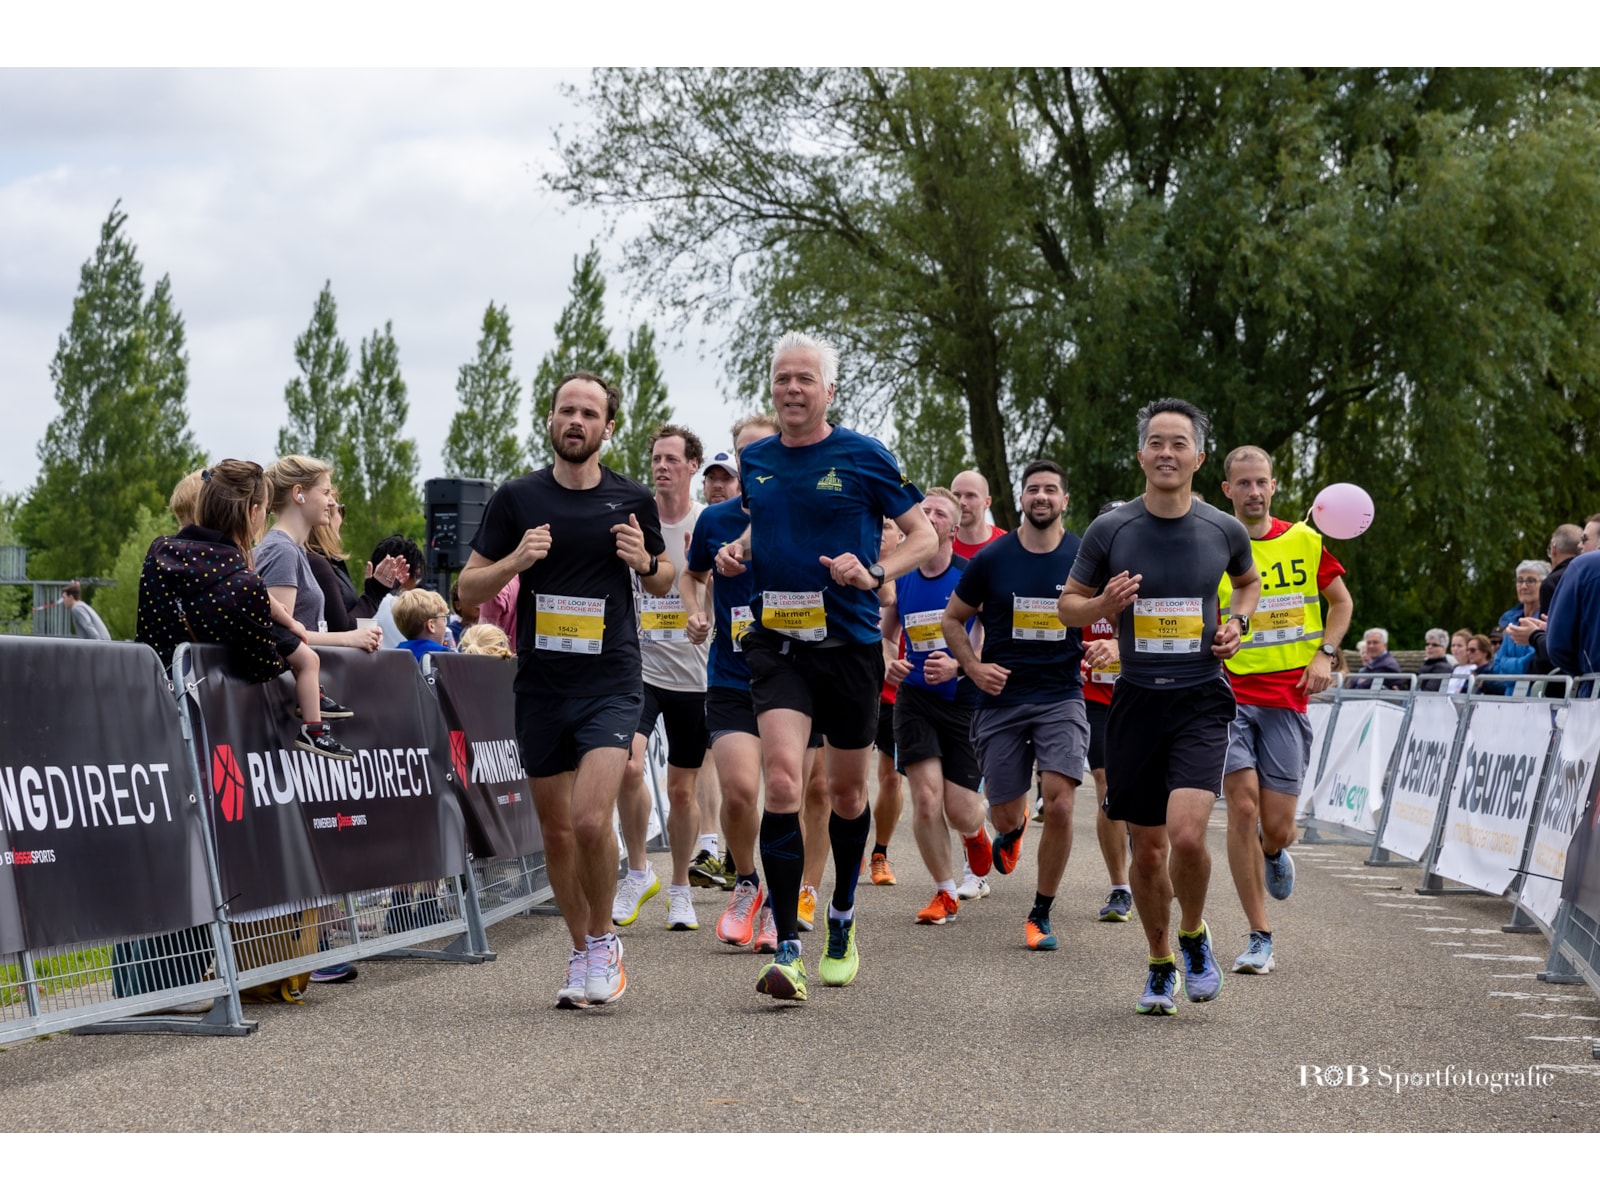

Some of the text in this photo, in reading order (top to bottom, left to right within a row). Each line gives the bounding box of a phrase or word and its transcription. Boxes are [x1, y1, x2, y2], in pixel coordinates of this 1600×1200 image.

[774, 610, 811, 618] Harmen
[1158, 618, 1177, 626] Ton
[247, 748, 432, 807] RUNNINGDIRECT
